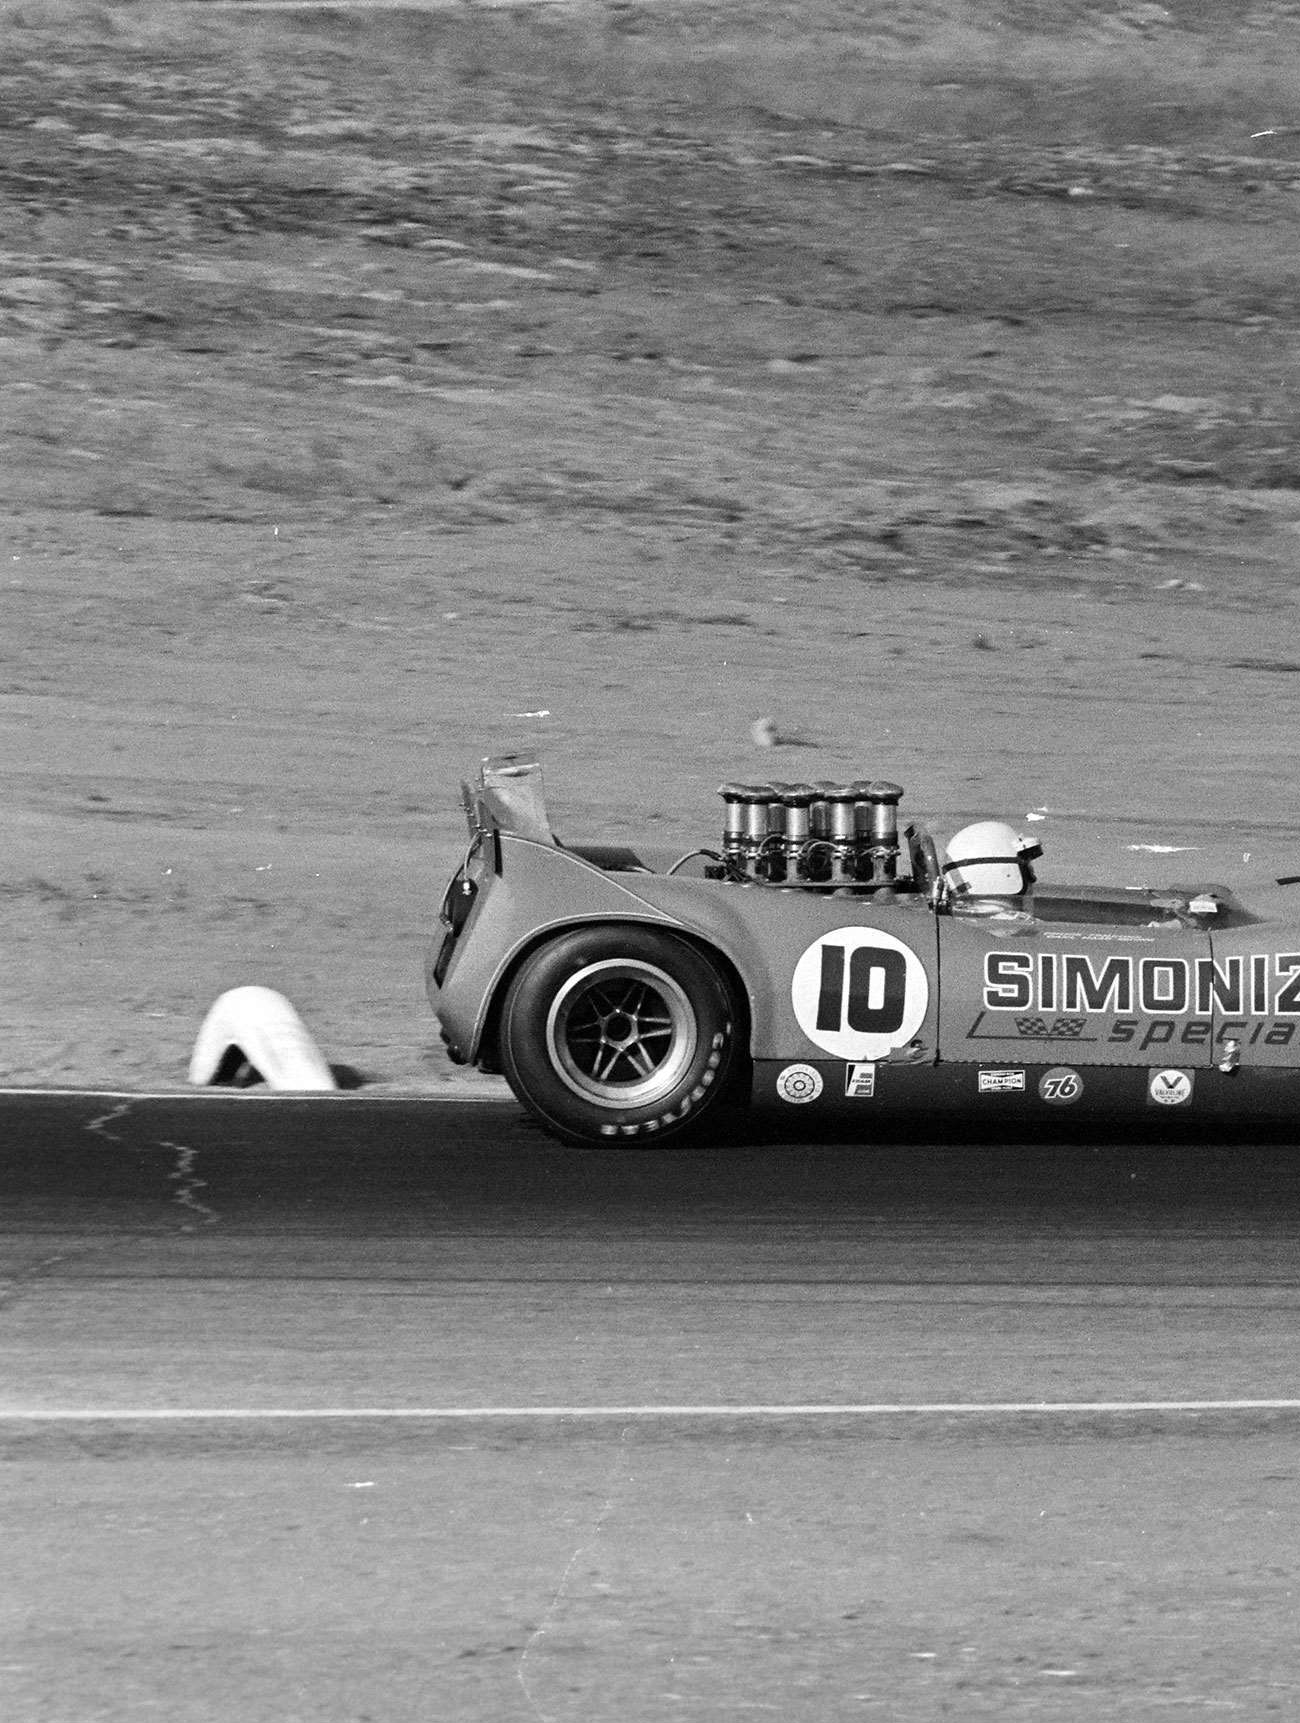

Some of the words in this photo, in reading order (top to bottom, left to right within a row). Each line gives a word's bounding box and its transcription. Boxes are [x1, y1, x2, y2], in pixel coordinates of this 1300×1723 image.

[816, 944, 907, 1035] 10
[982, 1078, 1022, 1086] CHAMPION
[1043, 1074, 1078, 1099] 76
